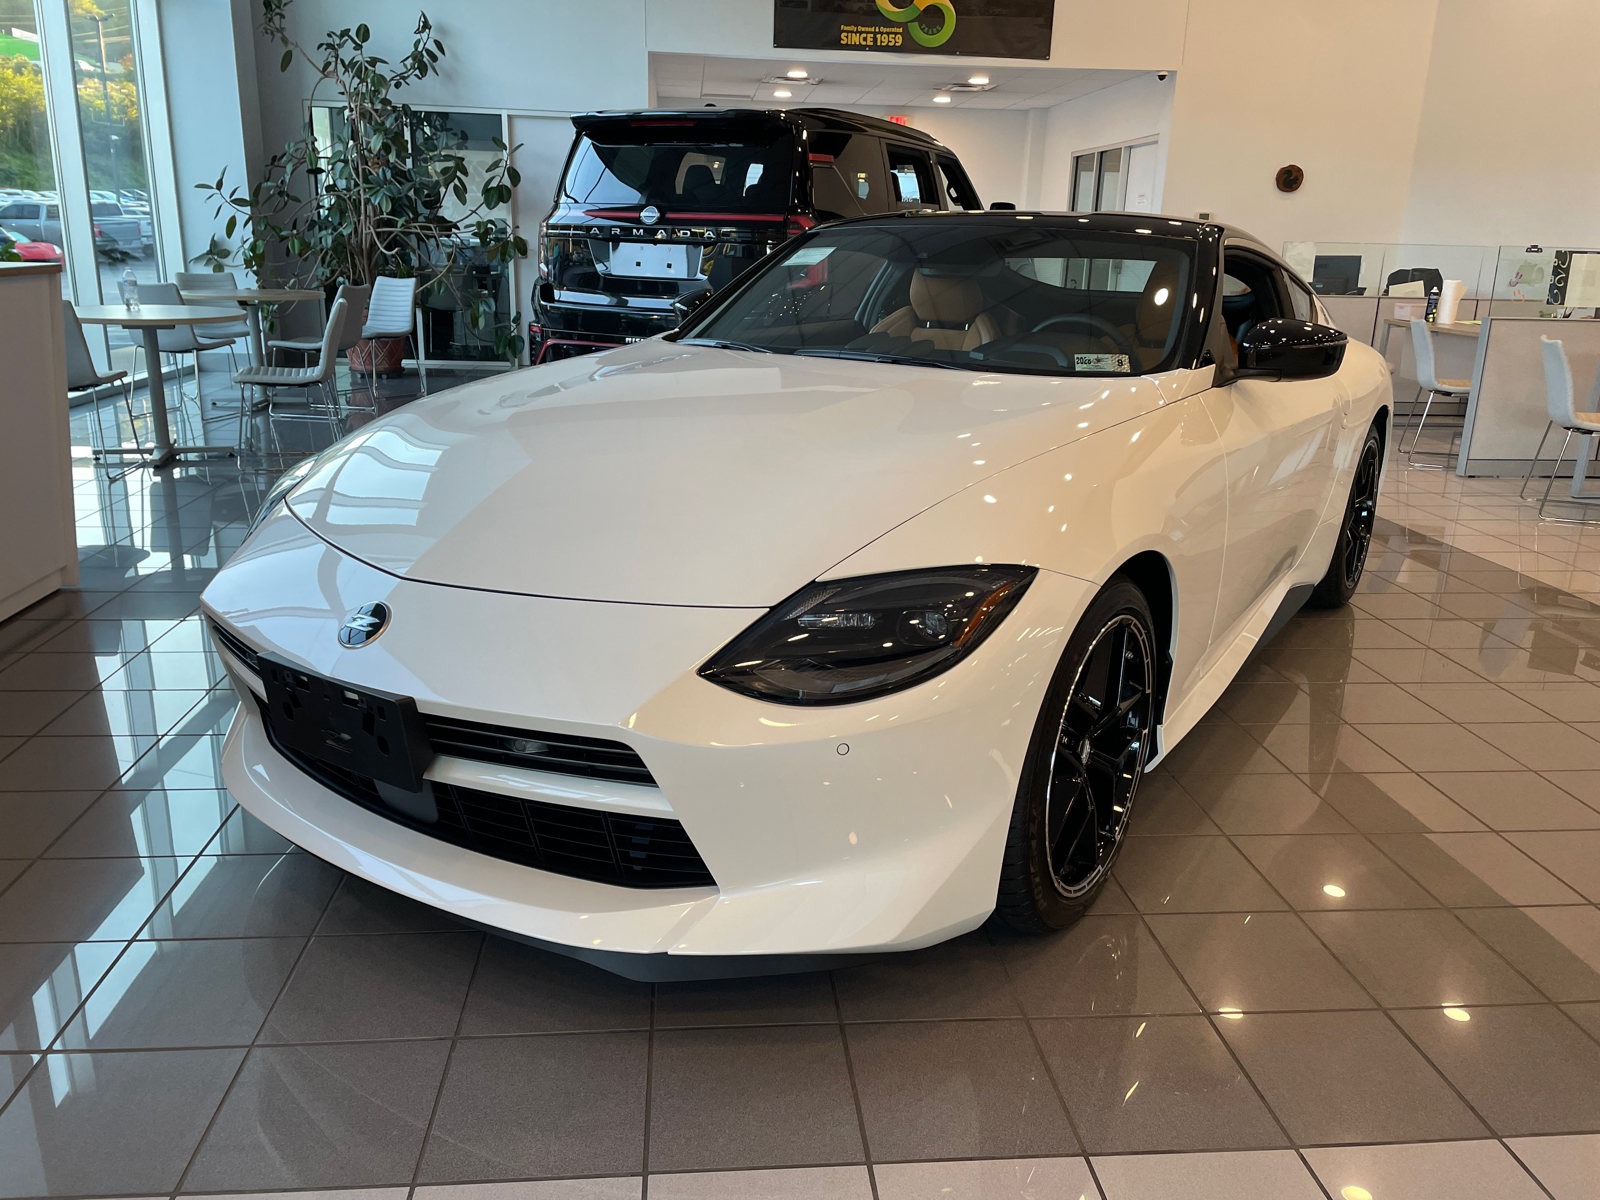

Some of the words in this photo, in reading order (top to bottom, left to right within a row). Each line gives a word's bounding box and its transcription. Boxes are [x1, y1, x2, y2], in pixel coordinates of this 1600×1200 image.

[921, 24, 941, 34] YEARS
[840, 32, 874, 45] SINCE
[876, 33, 903, 46] 1959
[589, 227, 716, 238] ARMADA
[1117, 358, 1124, 367] 9
